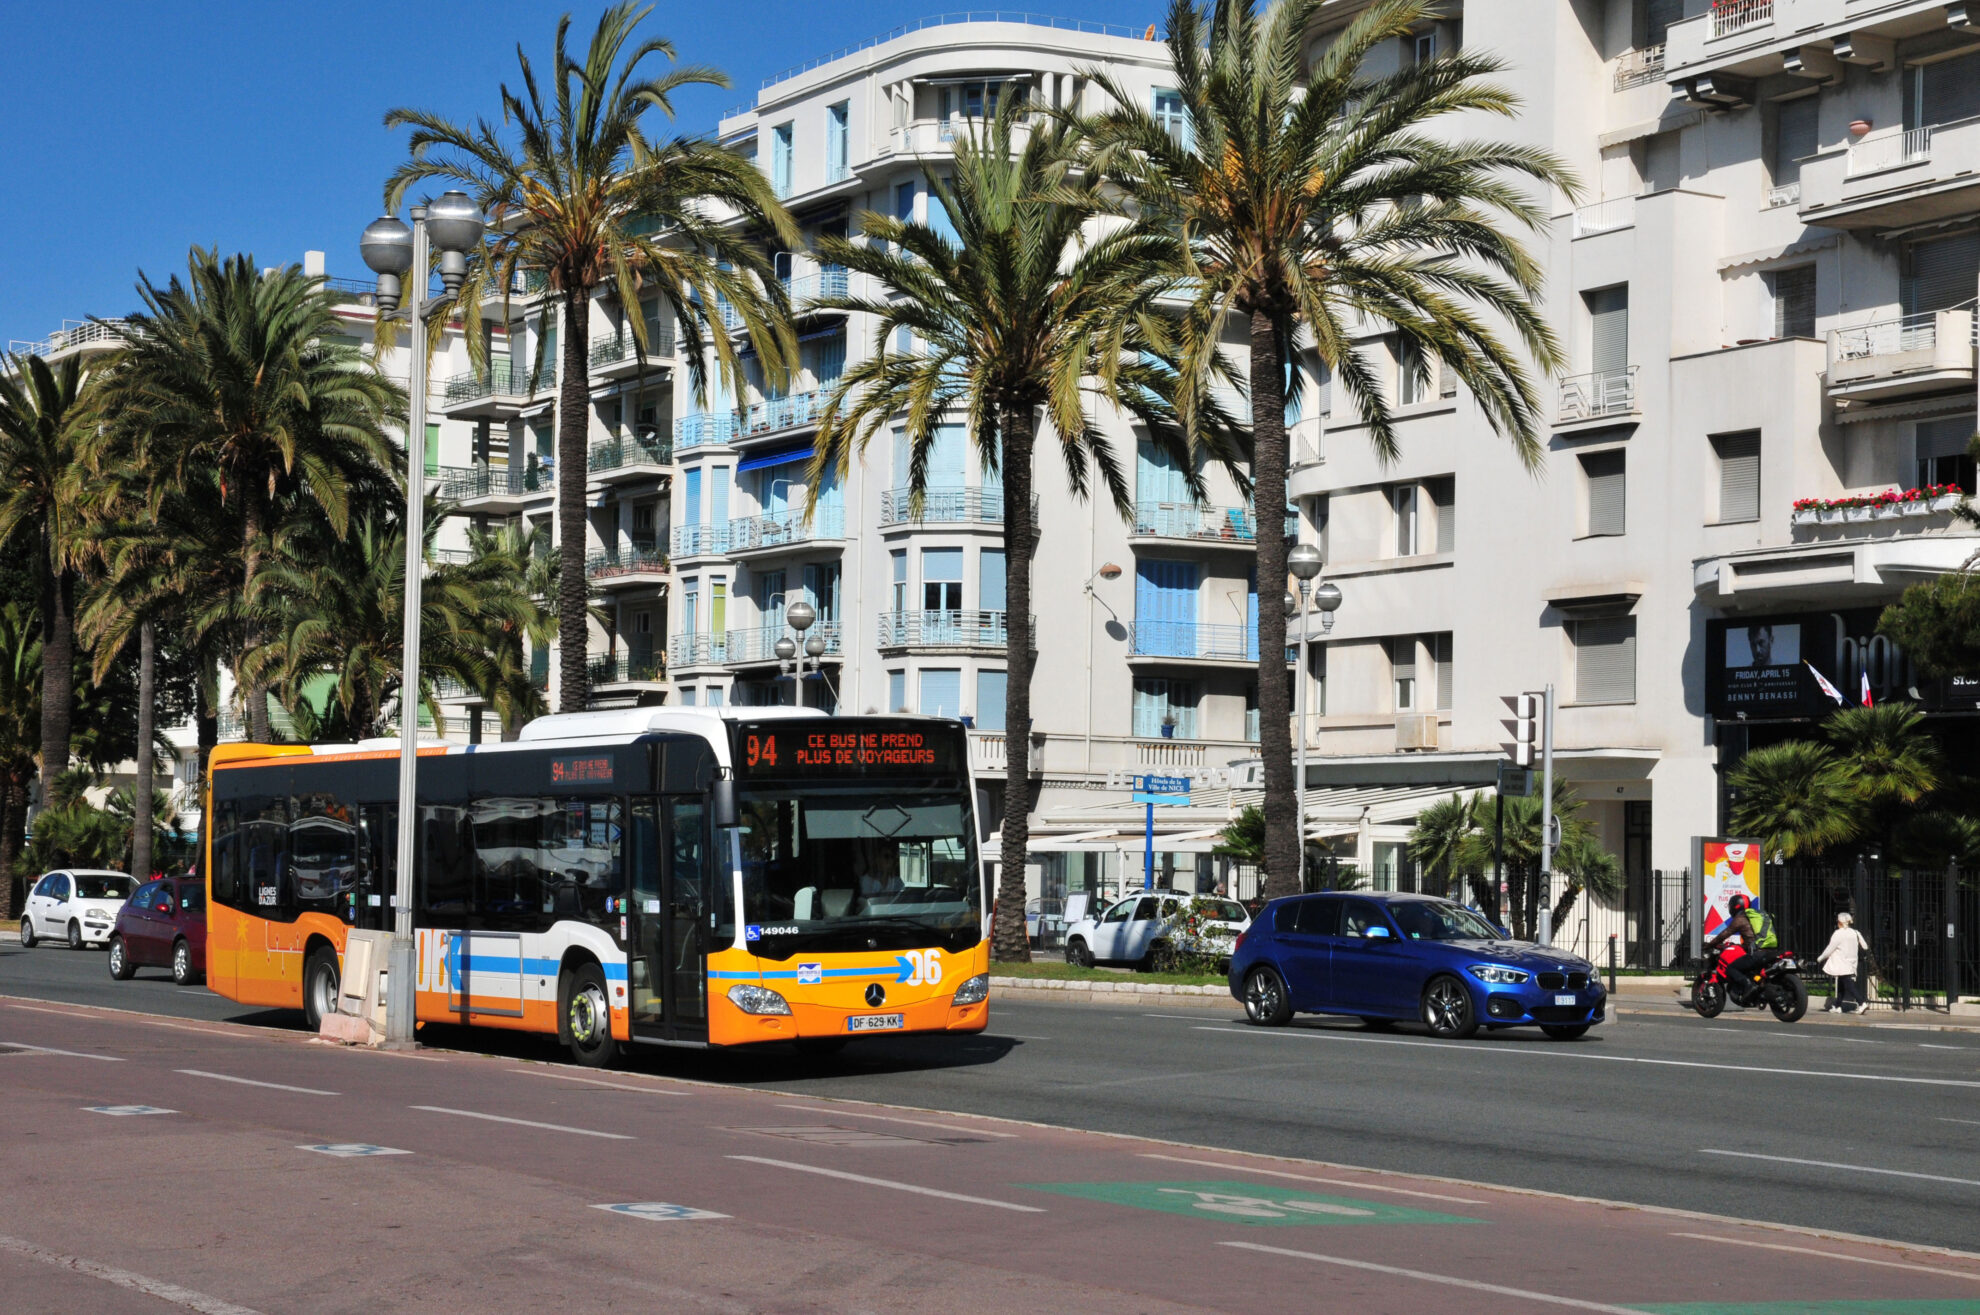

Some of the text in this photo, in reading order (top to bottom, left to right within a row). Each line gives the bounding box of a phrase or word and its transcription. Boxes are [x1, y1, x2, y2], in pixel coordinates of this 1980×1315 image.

[1735, 668, 1790, 680] FRIDAY, APRIL 15
[1727, 691, 1797, 701] BENNY BENASSI
[808, 733, 924, 748] CE BUS NE PREND
[747, 735, 777, 766] 94
[797, 749, 935, 764] PLUS DE VOYAGEURS
[552, 761, 564, 781] 94
[259, 886, 277, 896] LIGNES
[759, 926, 799, 935] 149046
[904, 949, 942, 987] 06
